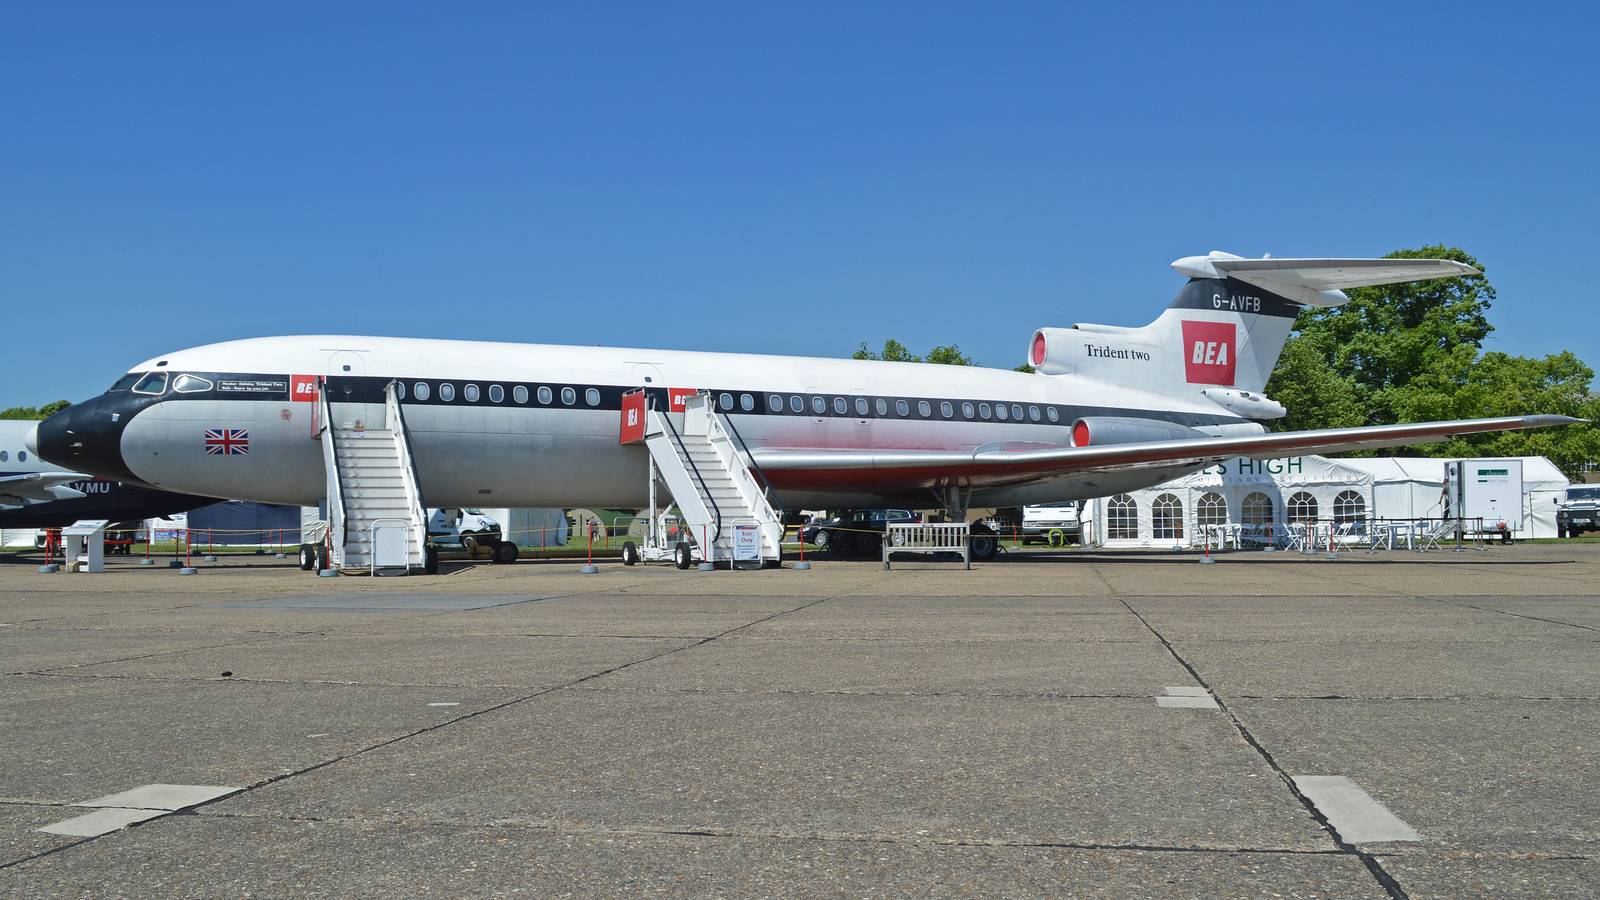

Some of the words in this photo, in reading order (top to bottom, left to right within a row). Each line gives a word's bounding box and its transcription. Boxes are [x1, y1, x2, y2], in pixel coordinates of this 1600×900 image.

[1212, 293, 1261, 312] G-AVFB
[1084, 343, 1129, 360] Trident
[1131, 349, 1150, 361] two
[1192, 340, 1228, 366] BEA
[1239, 457, 1302, 475] HIGH
